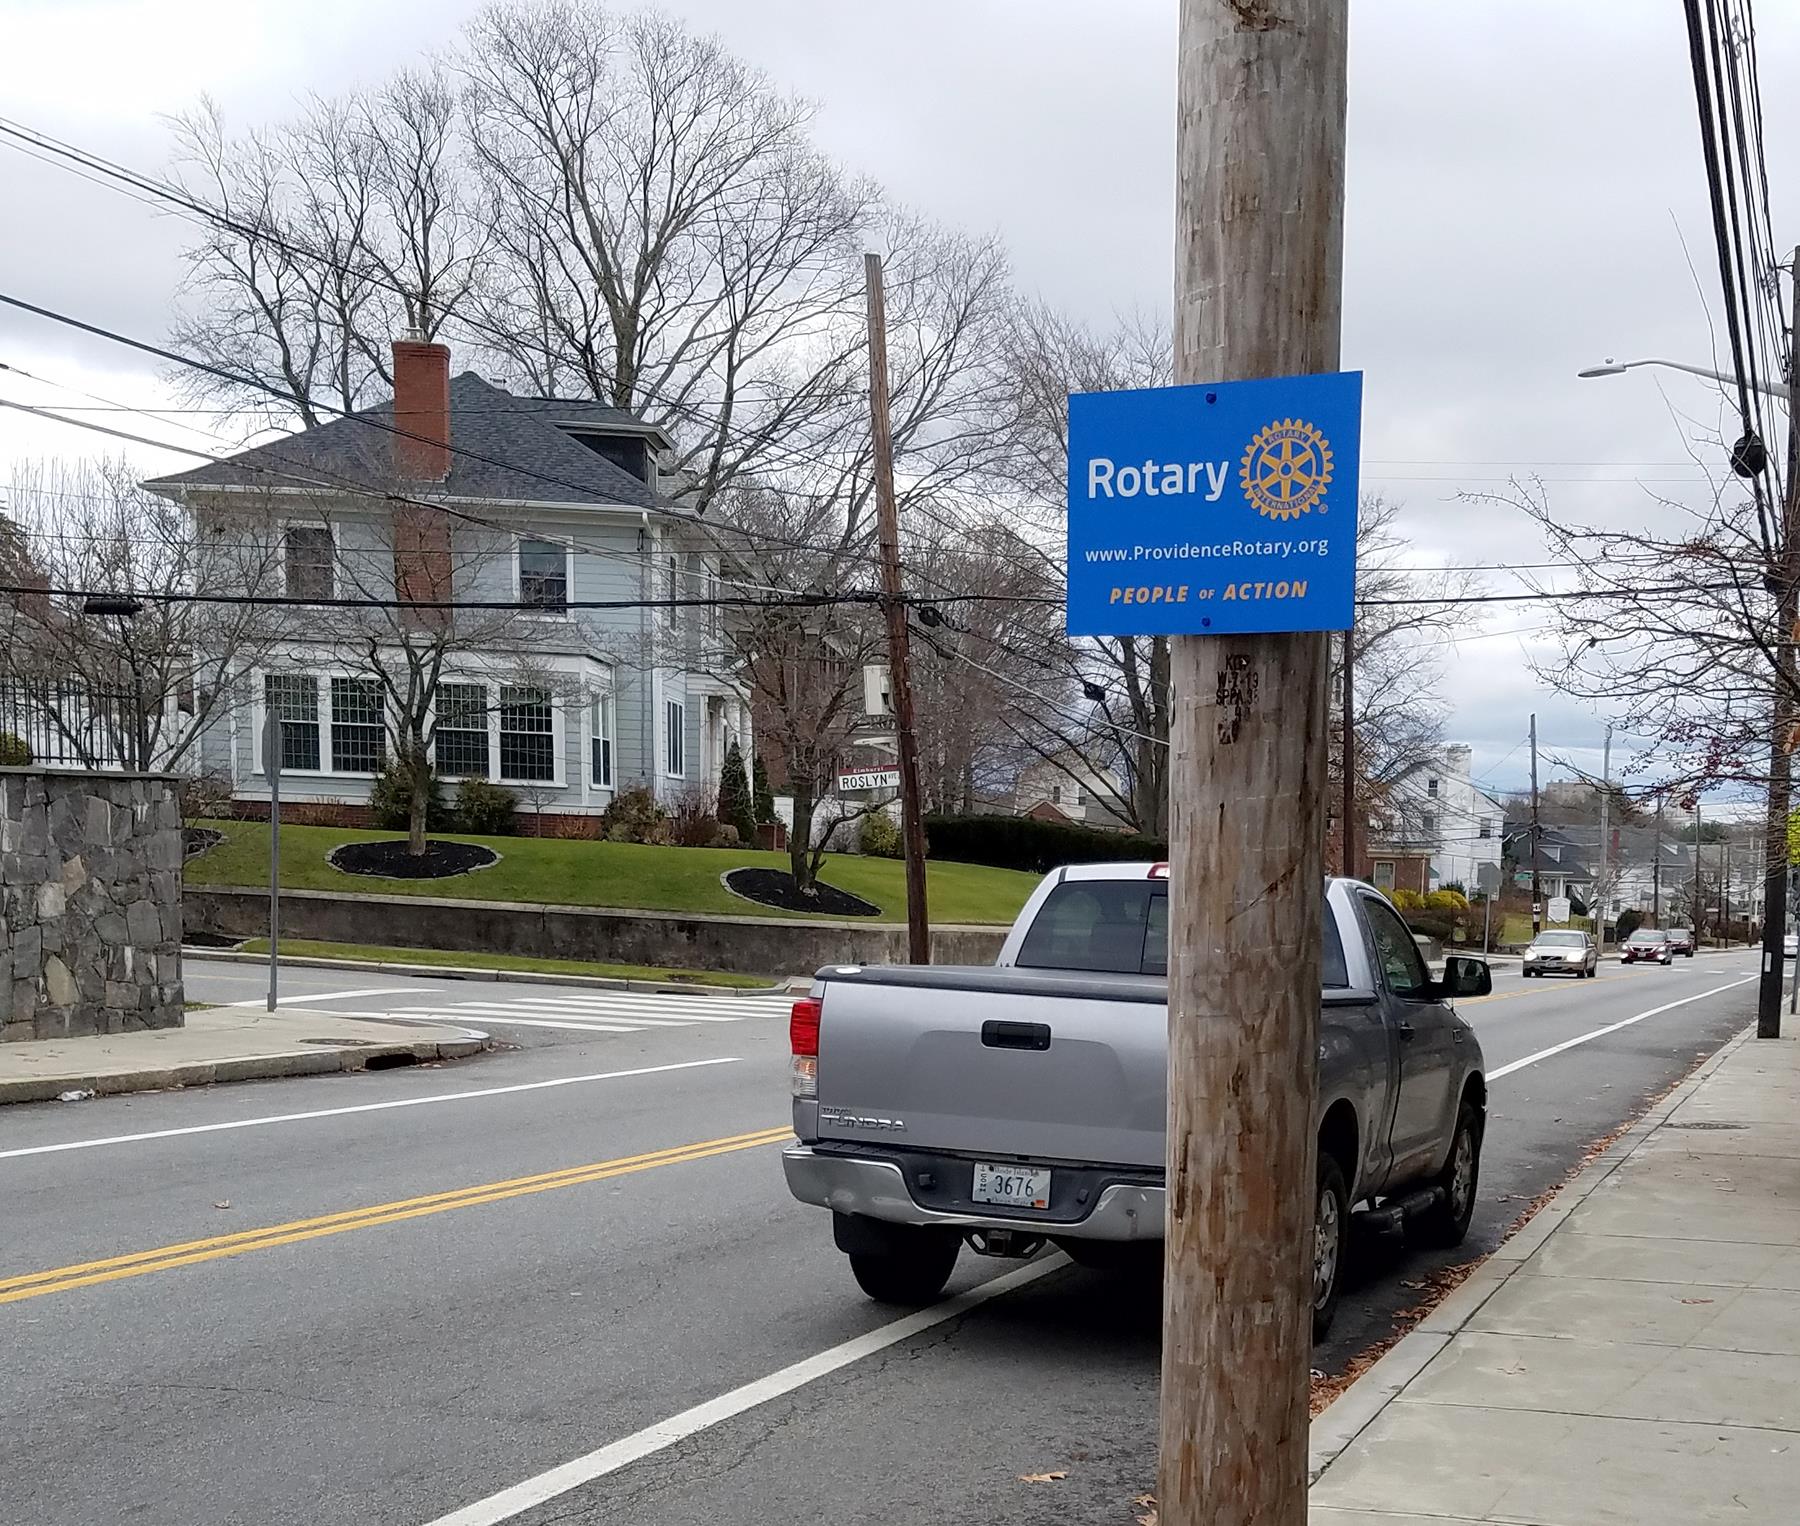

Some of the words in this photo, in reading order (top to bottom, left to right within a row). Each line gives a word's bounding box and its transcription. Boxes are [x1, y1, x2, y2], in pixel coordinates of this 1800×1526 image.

[1268, 428, 1308, 444] ROTARY
[1088, 457, 1229, 501] Rotary
[1252, 484, 1319, 510] INTERNATIONAL
[1085, 538, 1329, 562] www.ProvidenceRotary.org
[1109, 585, 1189, 604] PEOPLE
[1199, 588, 1215, 600] OF
[1222, 580, 1308, 601] ACTION
[842, 774, 888, 789] ROSLYN
[820, 1114, 908, 1133] TUNDRA
[994, 1174, 1034, 1197] 3676
